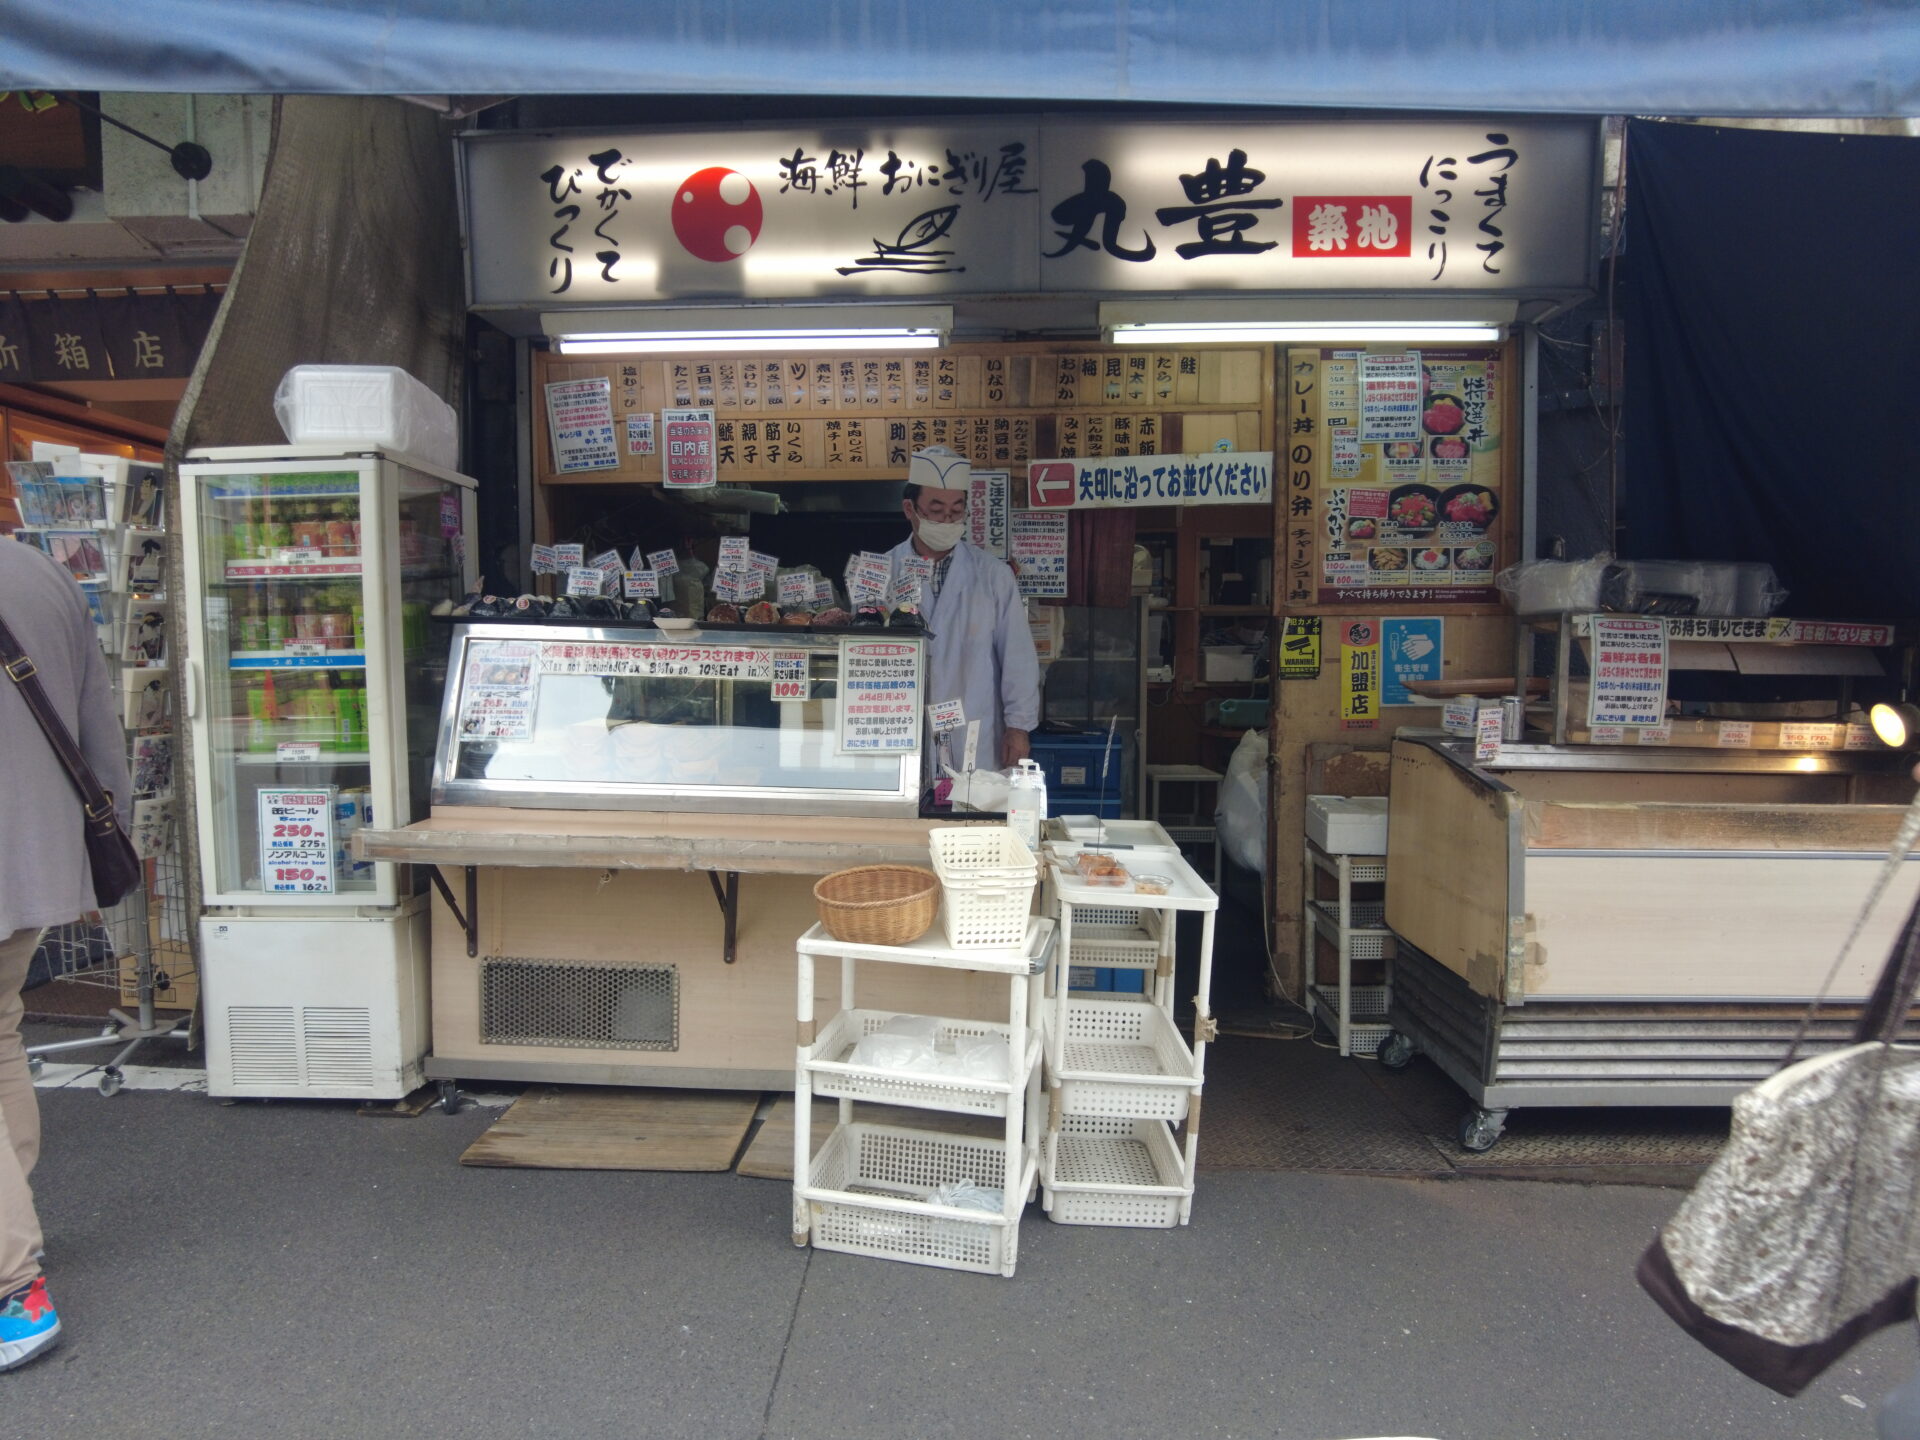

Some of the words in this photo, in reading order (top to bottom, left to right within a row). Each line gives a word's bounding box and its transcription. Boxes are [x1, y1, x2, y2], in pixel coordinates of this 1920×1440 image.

[589, 148, 633, 283] でかくて
[1042, 148, 1284, 262] 丸豊
[1420, 155, 1458, 281] にっこり
[1467, 133, 1519, 274] うまくて
[540, 165, 582, 294] びっくり
[1308, 205, 1399, 252] 築地
[696, 364, 714, 407] 五目飯
[744, 364, 758, 406] さけわび
[938, 359, 954, 400] たぬき
[987, 359, 1003, 401] いなり
[1058, 358, 1076, 399] おかか
[1082, 358, 1097, 376] 梅
[1129, 358, 1145, 399] 明太子
[1156, 357, 1172, 398] たら子
[1180, 356, 1196, 374] 鮭
[1293, 361, 1314, 434] カレー丼
[1463, 377, 1489, 447] 特選丼
[670, 441, 710, 456] 国内産
[741, 423, 758, 463] 親子
[765, 422, 781, 463] 筋子
[787, 422, 803, 463] いくら
[826, 421, 843, 463] 焼チーズ
[847, 421, 863, 463] 牛肉しぐれ
[890, 422, 907, 464] 助六
[974, 418, 989, 460] 山菜いなり
[994, 418, 1010, 460] 納豆巻
[1140, 416, 1156, 456] 赤飯
[1079, 464, 1267, 502] 矢印に沿ってお並びください
[1291, 444, 1313, 517] のり弁
[1327, 488, 1347, 550] ぶっかけ丼
[1290, 528, 1311, 600] チャーシュー丼
[1285, 658, 1315, 666] WARNING
[1600, 652, 1662, 664] 海鮮丼各種
[1351, 650, 1369, 715] 加盟店
[271, 807, 318, 815] 缶ビール
